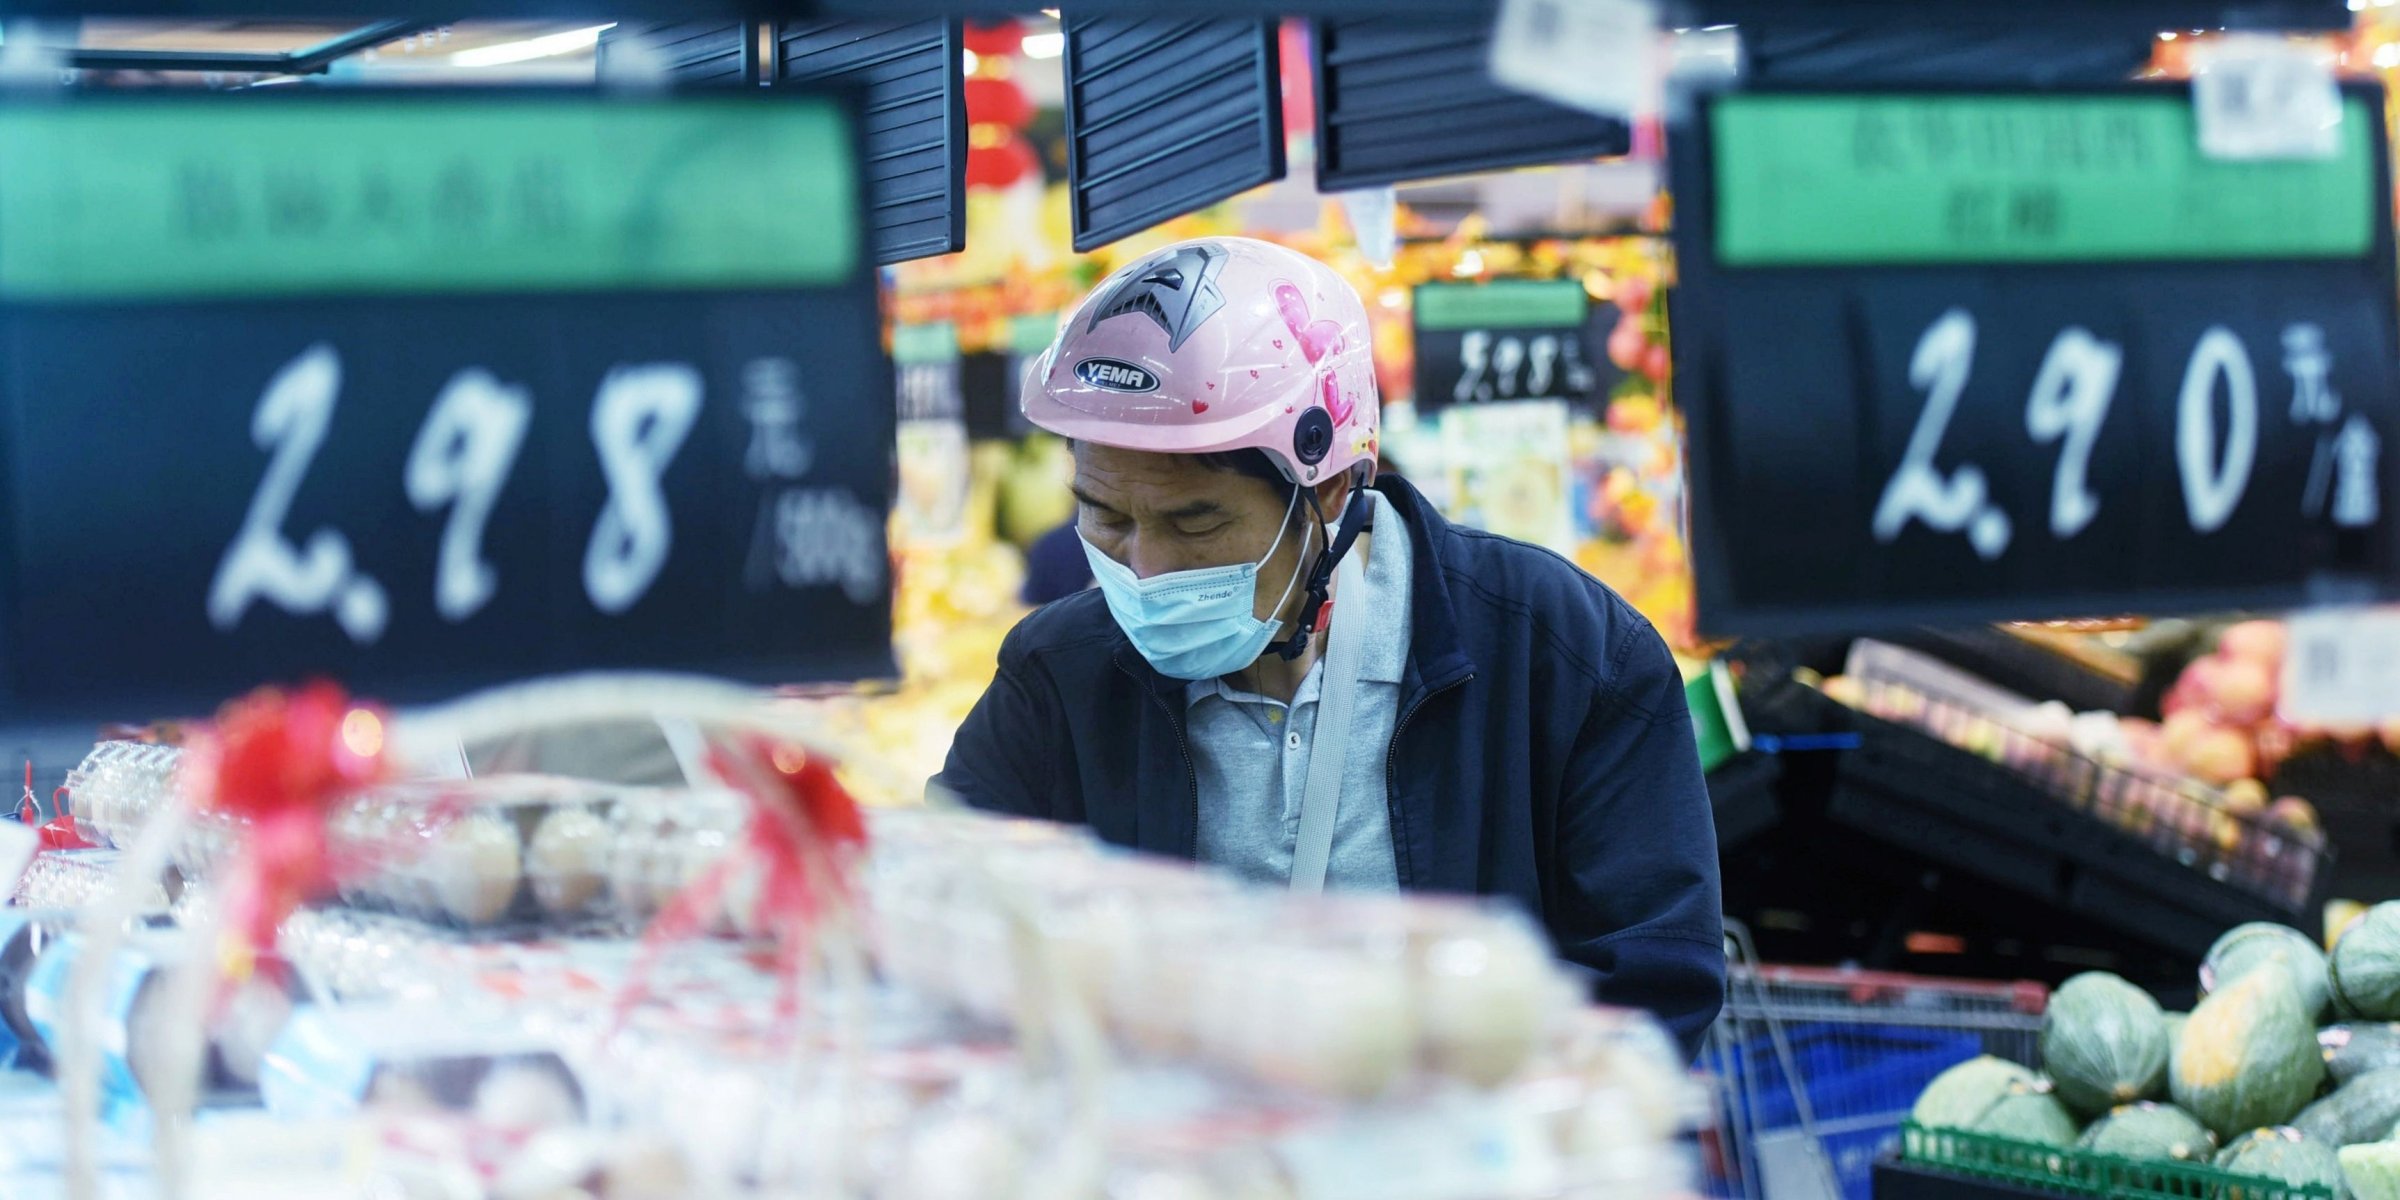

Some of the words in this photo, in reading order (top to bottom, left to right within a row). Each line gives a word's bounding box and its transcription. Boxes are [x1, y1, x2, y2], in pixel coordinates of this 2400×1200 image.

[210, 343, 706, 642] 2.98
[1087, 362, 1144, 387] YEMA
[1873, 309, 2259, 559] 2.90
